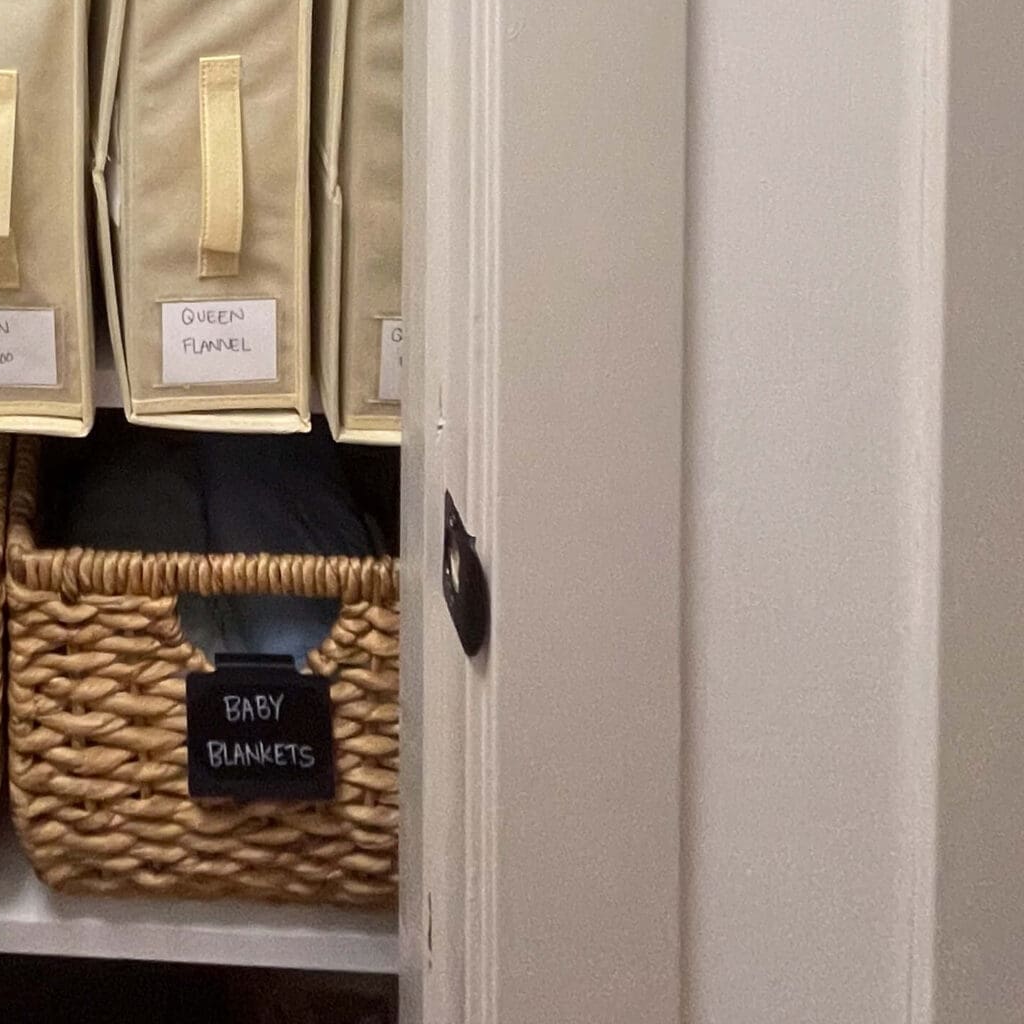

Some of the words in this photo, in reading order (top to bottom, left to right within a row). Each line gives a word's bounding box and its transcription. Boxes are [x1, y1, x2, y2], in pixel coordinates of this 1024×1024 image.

[180, 306, 245, 326] QUEEN
[182, 337, 252, 355] FLANNEL
[222, 693, 285, 723] BABY
[206, 739, 316, 769] BLANKETS
